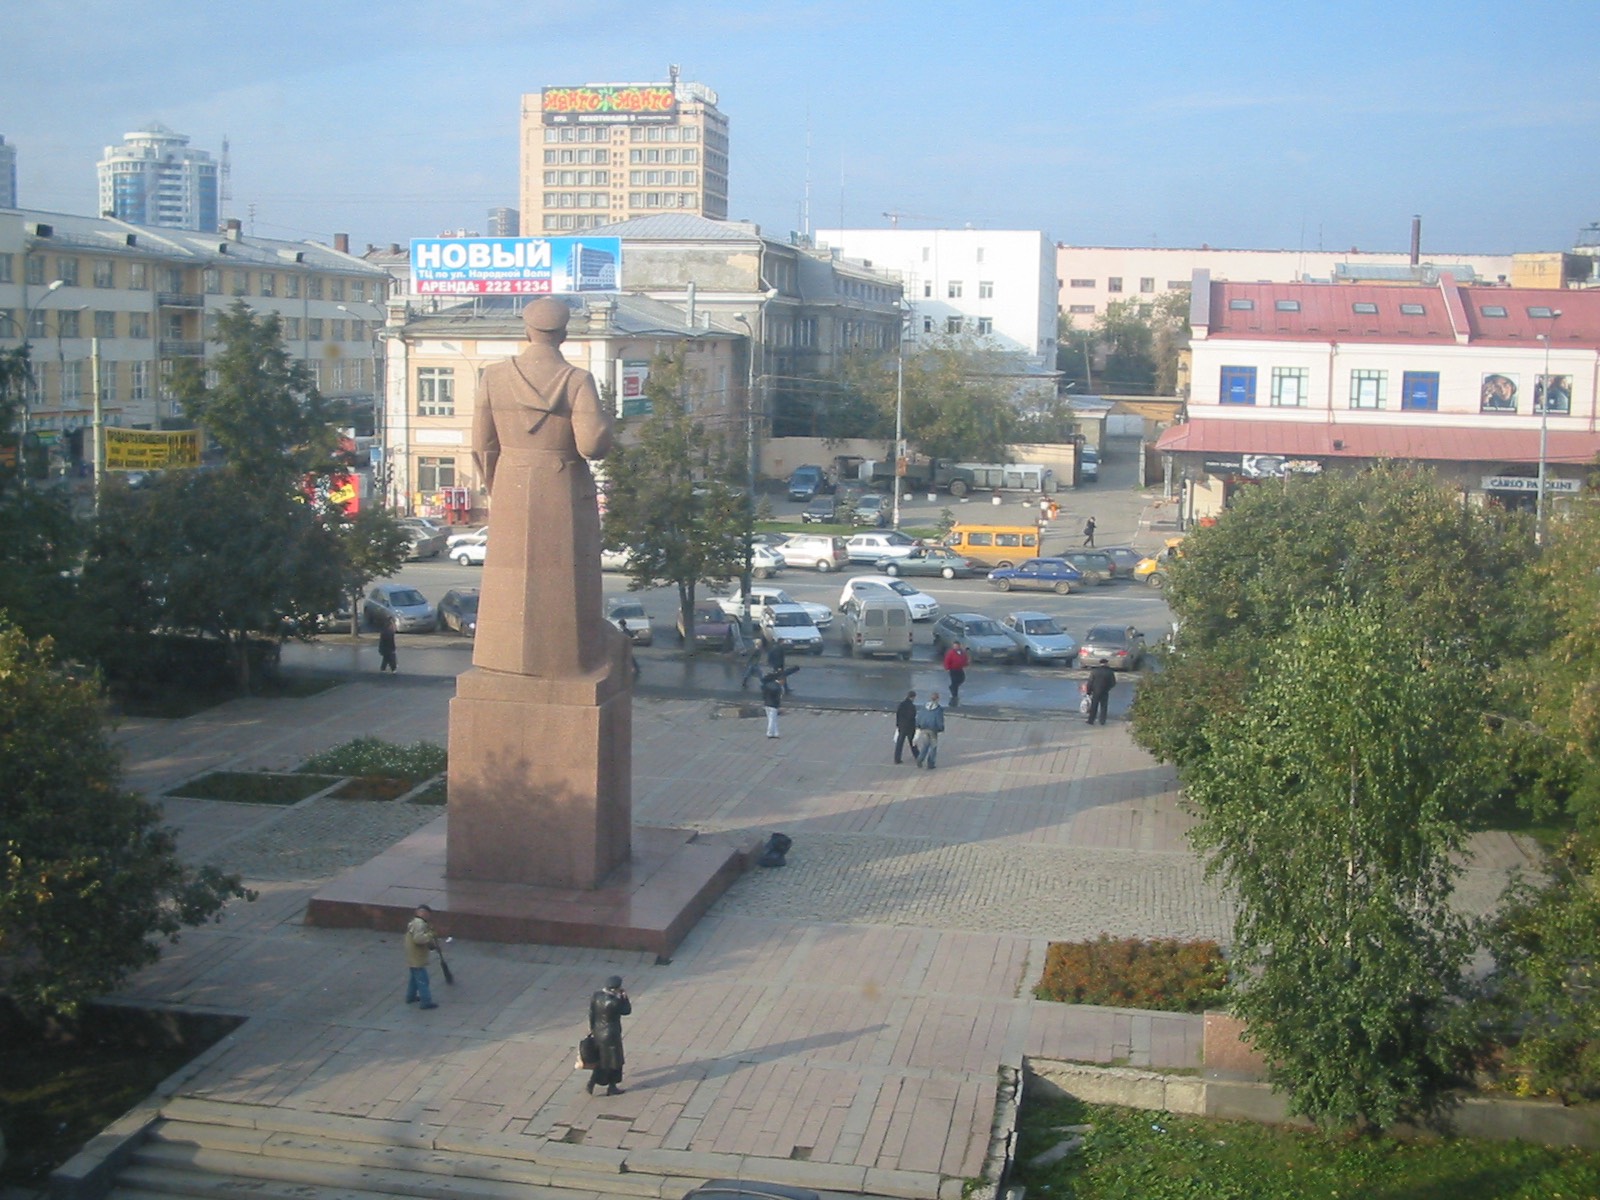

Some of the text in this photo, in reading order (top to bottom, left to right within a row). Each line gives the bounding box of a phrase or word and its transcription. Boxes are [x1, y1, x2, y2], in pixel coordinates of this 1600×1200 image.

[417, 239, 551, 268] НОВЫЙ
[419, 270, 433, 279] ТЦ
[451, 271, 466, 280] ул.
[469, 269, 520, 280] Народной
[523, 270, 551, 278] Воли
[421, 281, 549, 293] АРЕНДА: 222 1234
[1490, 478, 1572, 490] CARLO PAOLINI
